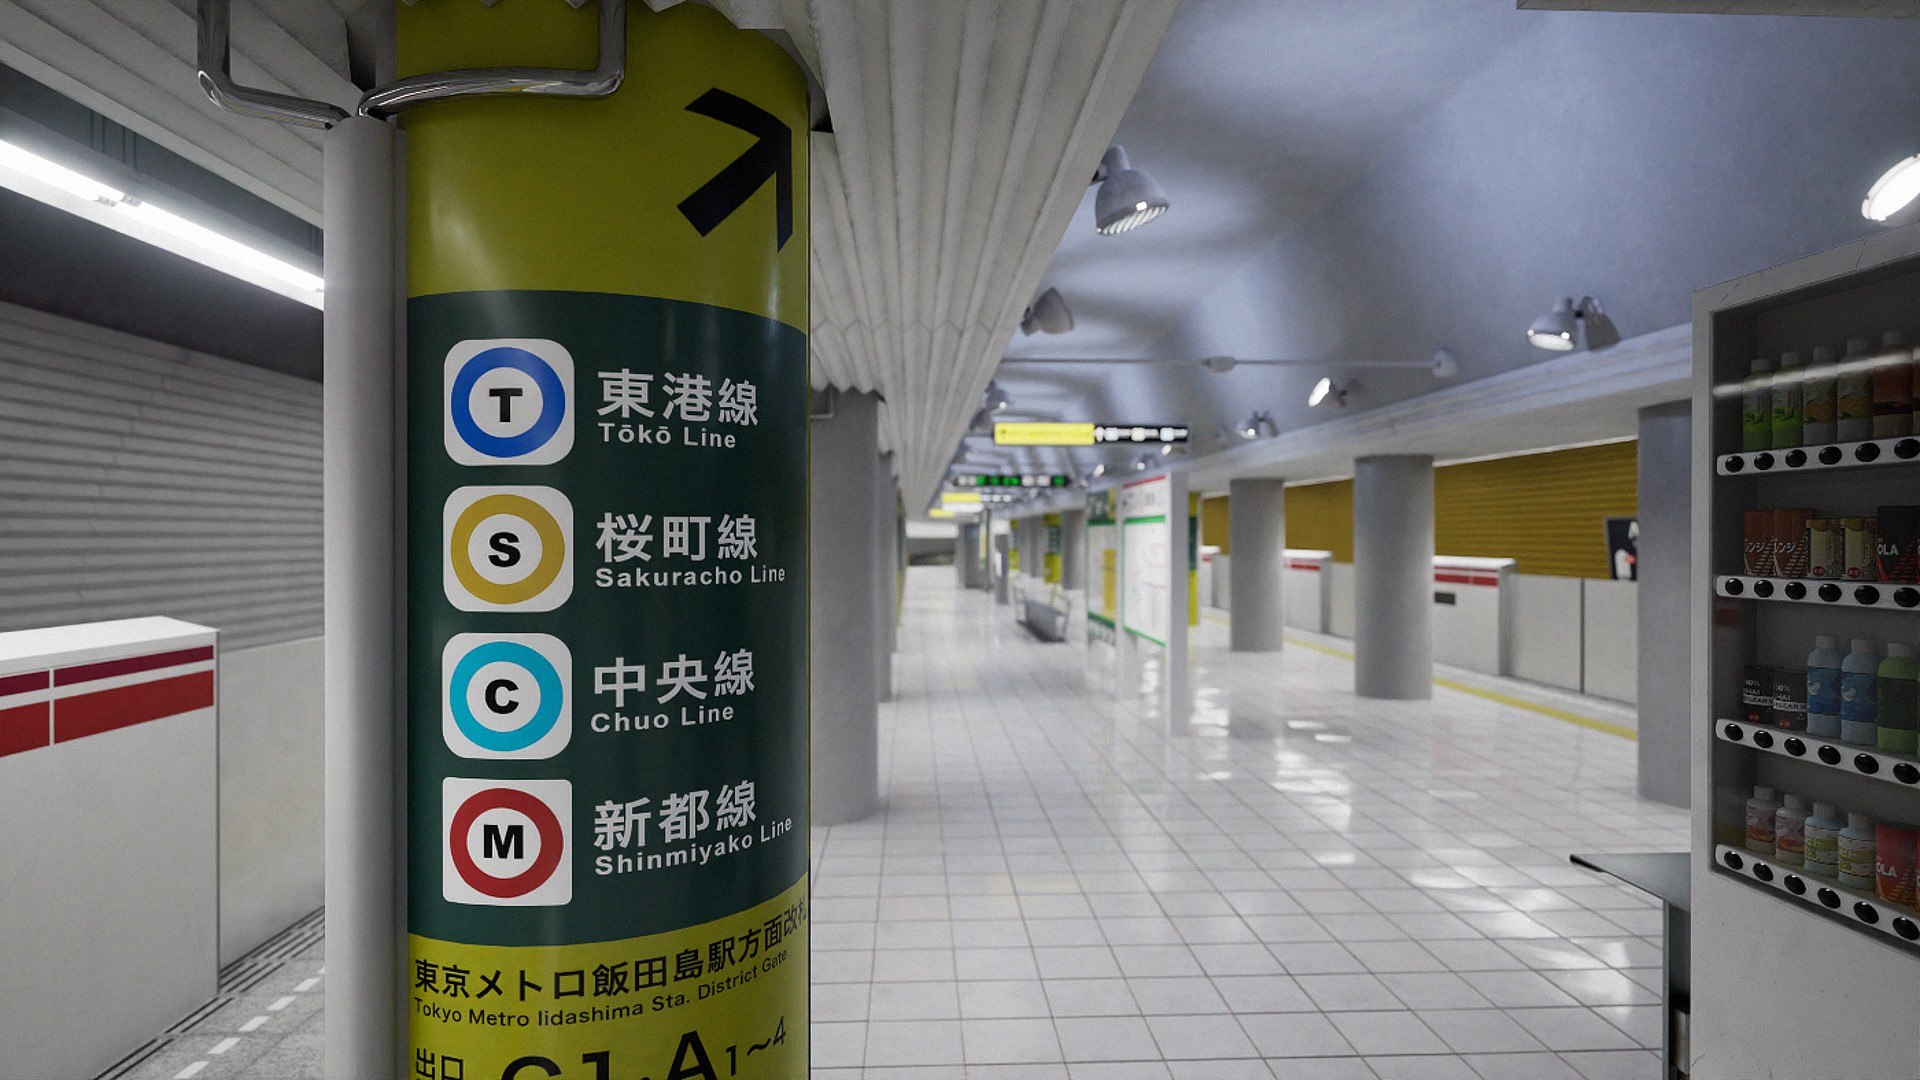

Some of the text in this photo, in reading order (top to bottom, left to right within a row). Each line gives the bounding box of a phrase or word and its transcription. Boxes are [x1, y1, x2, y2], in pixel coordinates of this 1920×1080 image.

[489, 387, 523, 423] T
[597, 368, 760, 426] 東港線
[598, 422, 737, 449] Tōkō Line
[488, 531, 521, 567] S
[596, 511, 758, 563] 桜町線
[595, 564, 786, 588] Sakuracho Line
[593, 648, 756, 708] 中央線
[484, 679, 519, 715] C
[590, 703, 735, 733] Chuo Line
[593, 779, 757, 852] 新都線
[482, 824, 524, 859] M
[594, 815, 793, 876] Shinmiyako Line
[414, 948, 788, 1028] Tokyo Metro Iidashima Sta. District Gate
[415, 1048, 465, 1080] 出口
